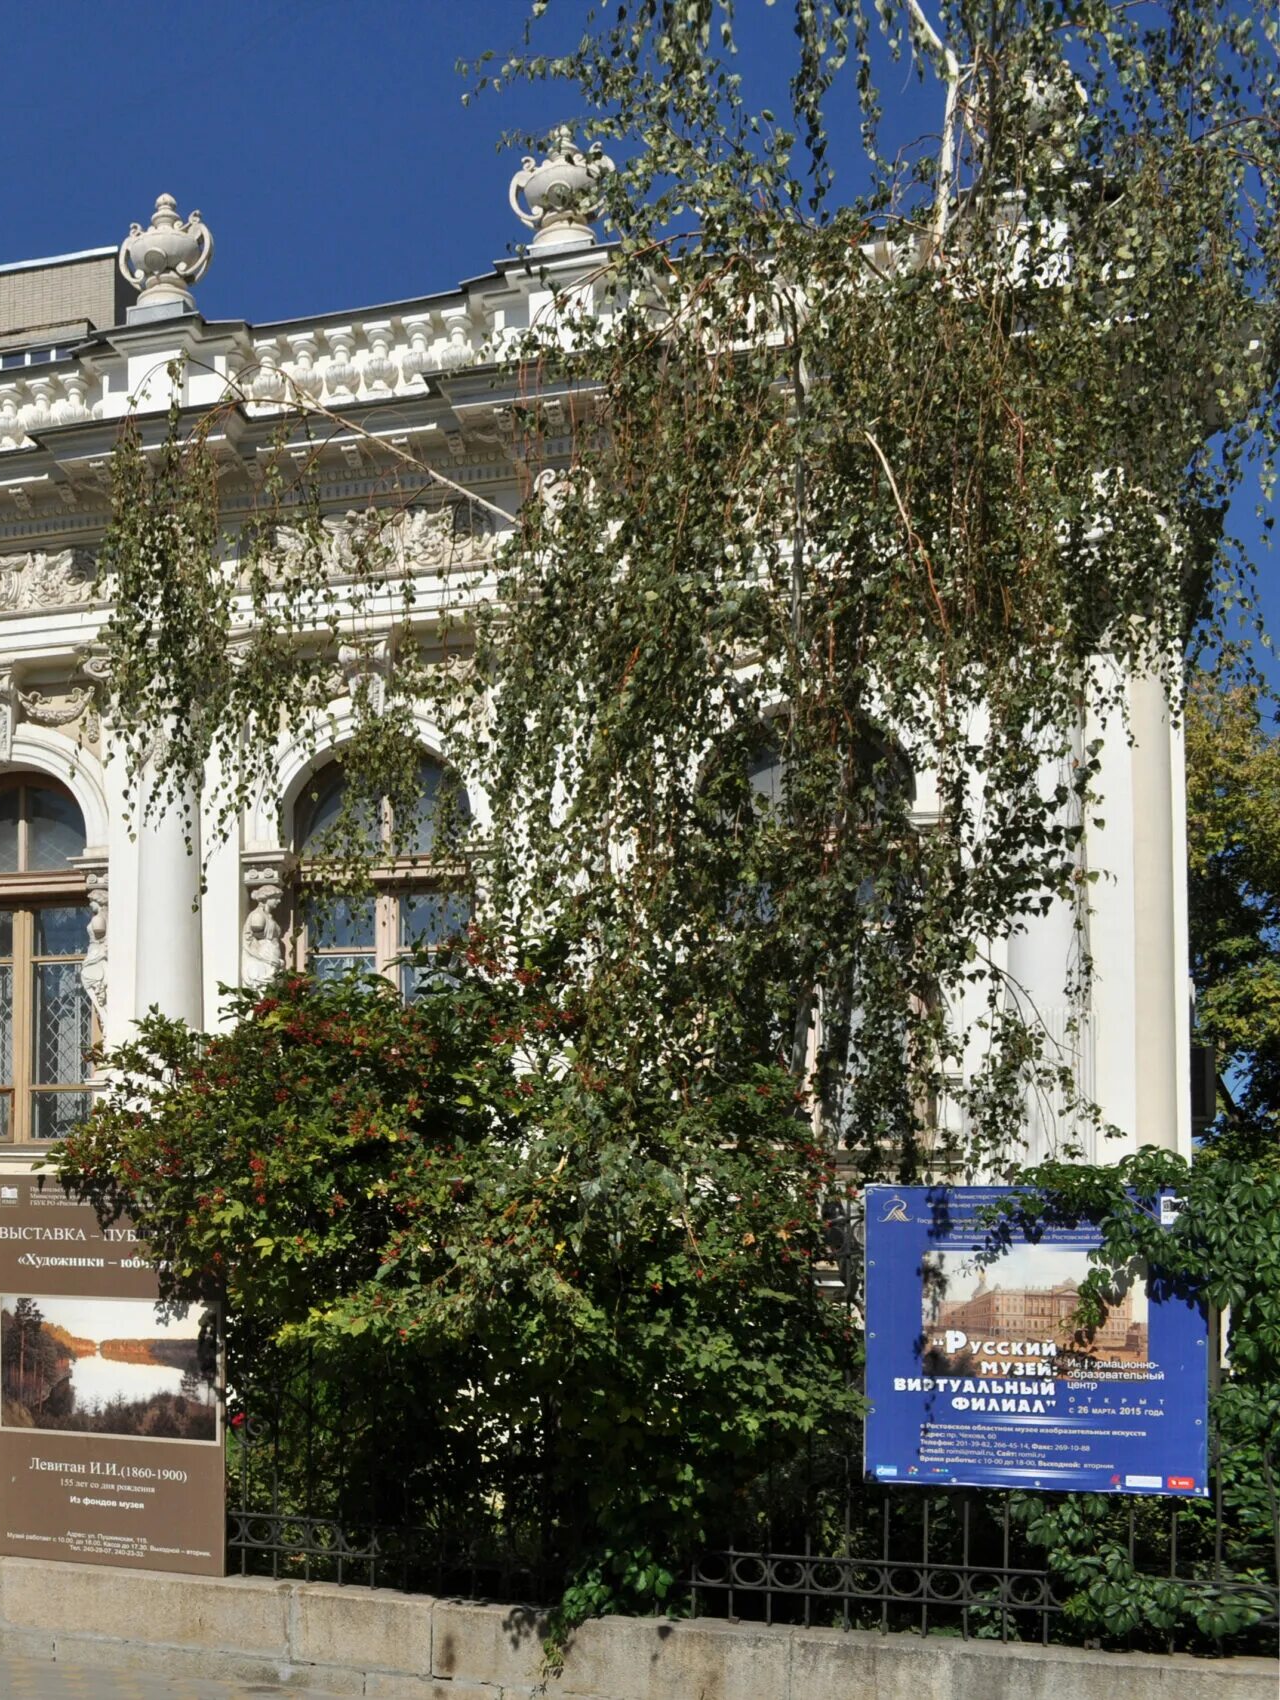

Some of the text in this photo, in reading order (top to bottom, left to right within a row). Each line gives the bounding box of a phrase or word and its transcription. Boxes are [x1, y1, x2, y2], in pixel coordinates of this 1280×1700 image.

[17, 1252, 104, 1269] «Художники
[980, 1359, 1058, 1377] МУЗЕЙ:
[1067, 1368, 1165, 1380] образовательный
[893, 1376, 1056, 1396] ВИРТУАЛЬНЫЙ
[1066, 1381, 1098, 1391] центр
[1077, 1405, 1089, 1414] 26
[1119, 1406, 1142, 1416] 2015
[971, 1424, 1014, 1432] областном
[1039, 1426, 1111, 1436] изобразительных
[1112, 1430, 1147, 1438] искусств
[28, 1457, 86, 1475] Левитан
[60, 1477, 74, 1487] 155
[75, 1480, 88, 1489] лет
[100, 1483, 115, 1491] дня
[116, 1483, 156, 1493] рождения
[70, 1495, 145, 1510] Из фондов музея
